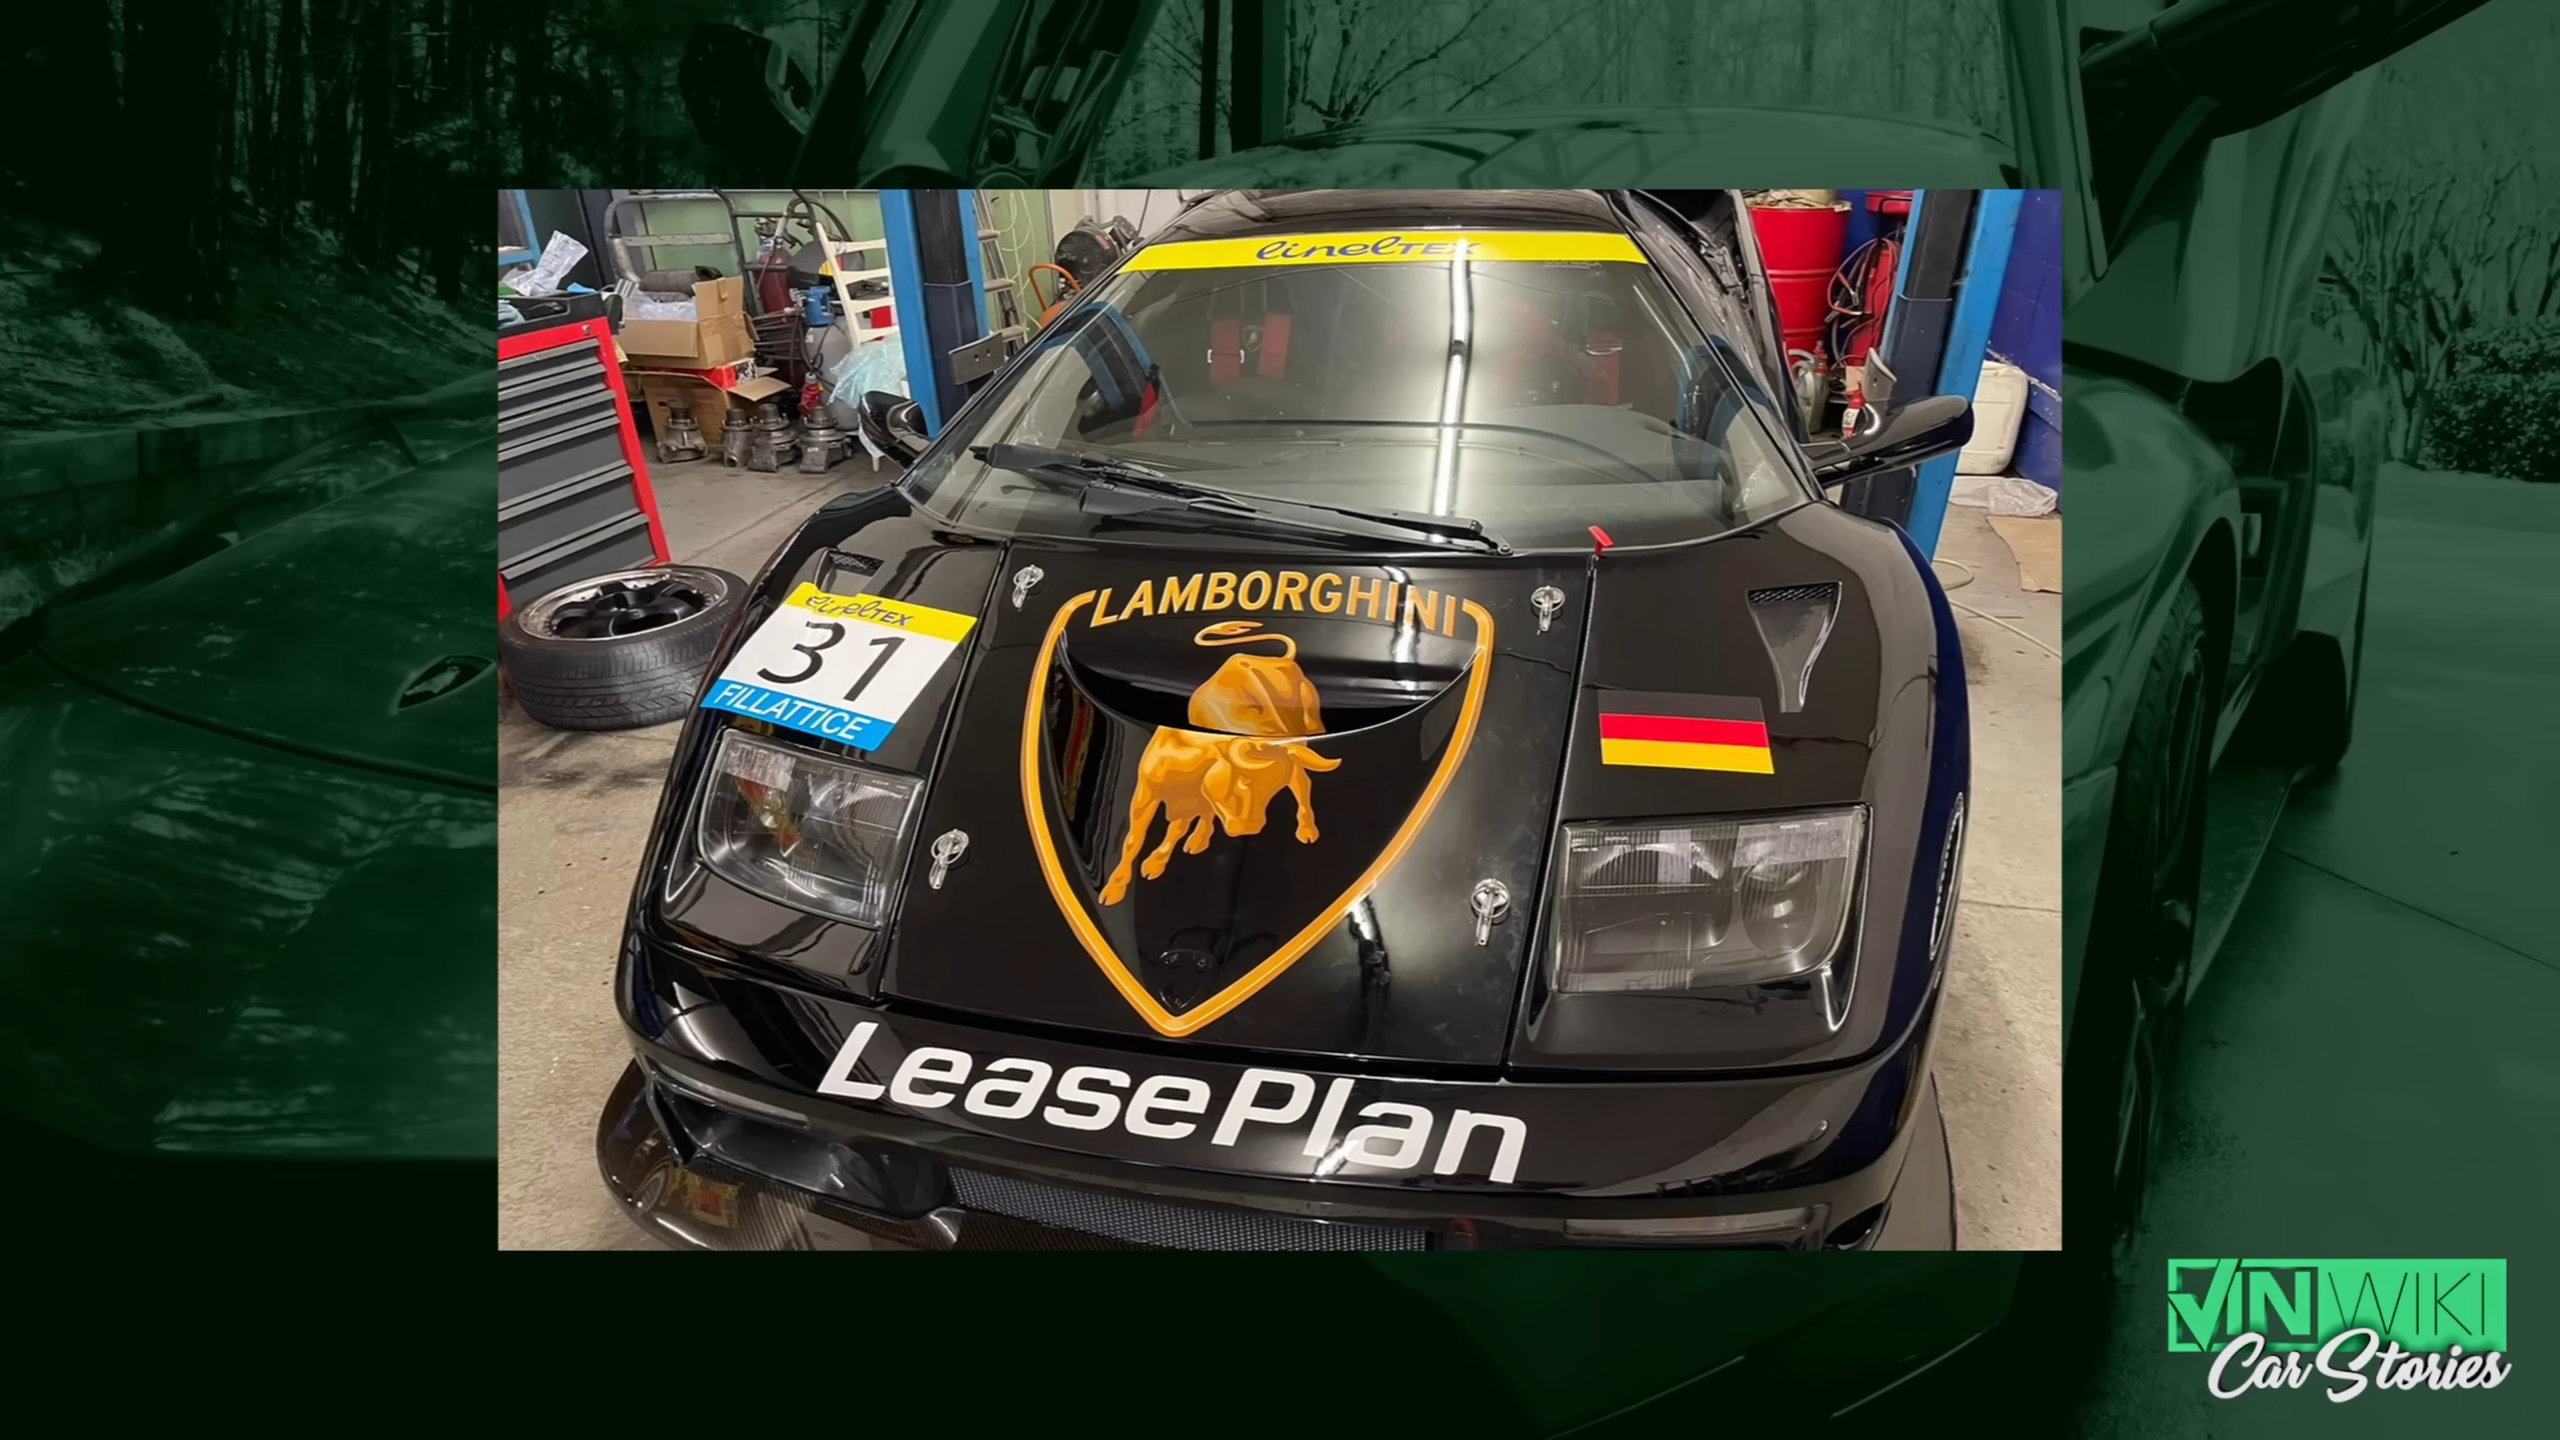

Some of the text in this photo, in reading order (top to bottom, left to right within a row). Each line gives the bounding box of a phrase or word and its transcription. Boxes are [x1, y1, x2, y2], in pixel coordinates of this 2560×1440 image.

[1090, 570, 1455, 637] LAMBORGHINI
[757, 621, 906, 702] 31
[713, 683, 871, 740] FILLATTICE
